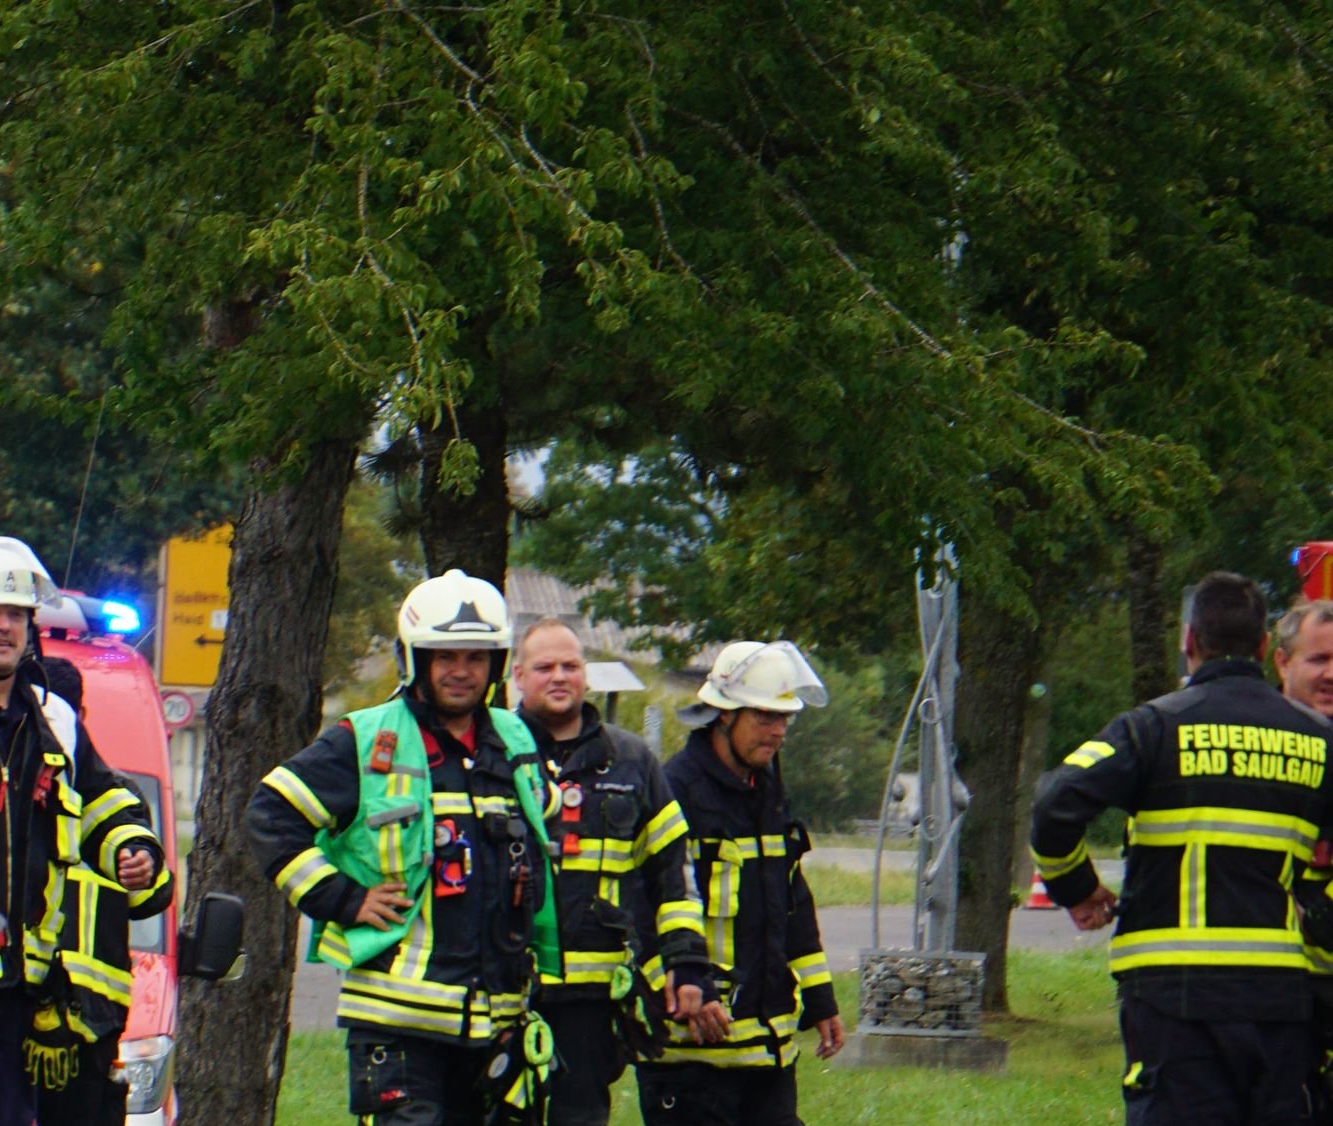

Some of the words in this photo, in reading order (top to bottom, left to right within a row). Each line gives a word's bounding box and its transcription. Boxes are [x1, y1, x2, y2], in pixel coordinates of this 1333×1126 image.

[1178, 724, 1327, 763] FEUERWEHR
[1179, 750, 1228, 777] BAD
[1232, 751, 1325, 789] SAULGAU
